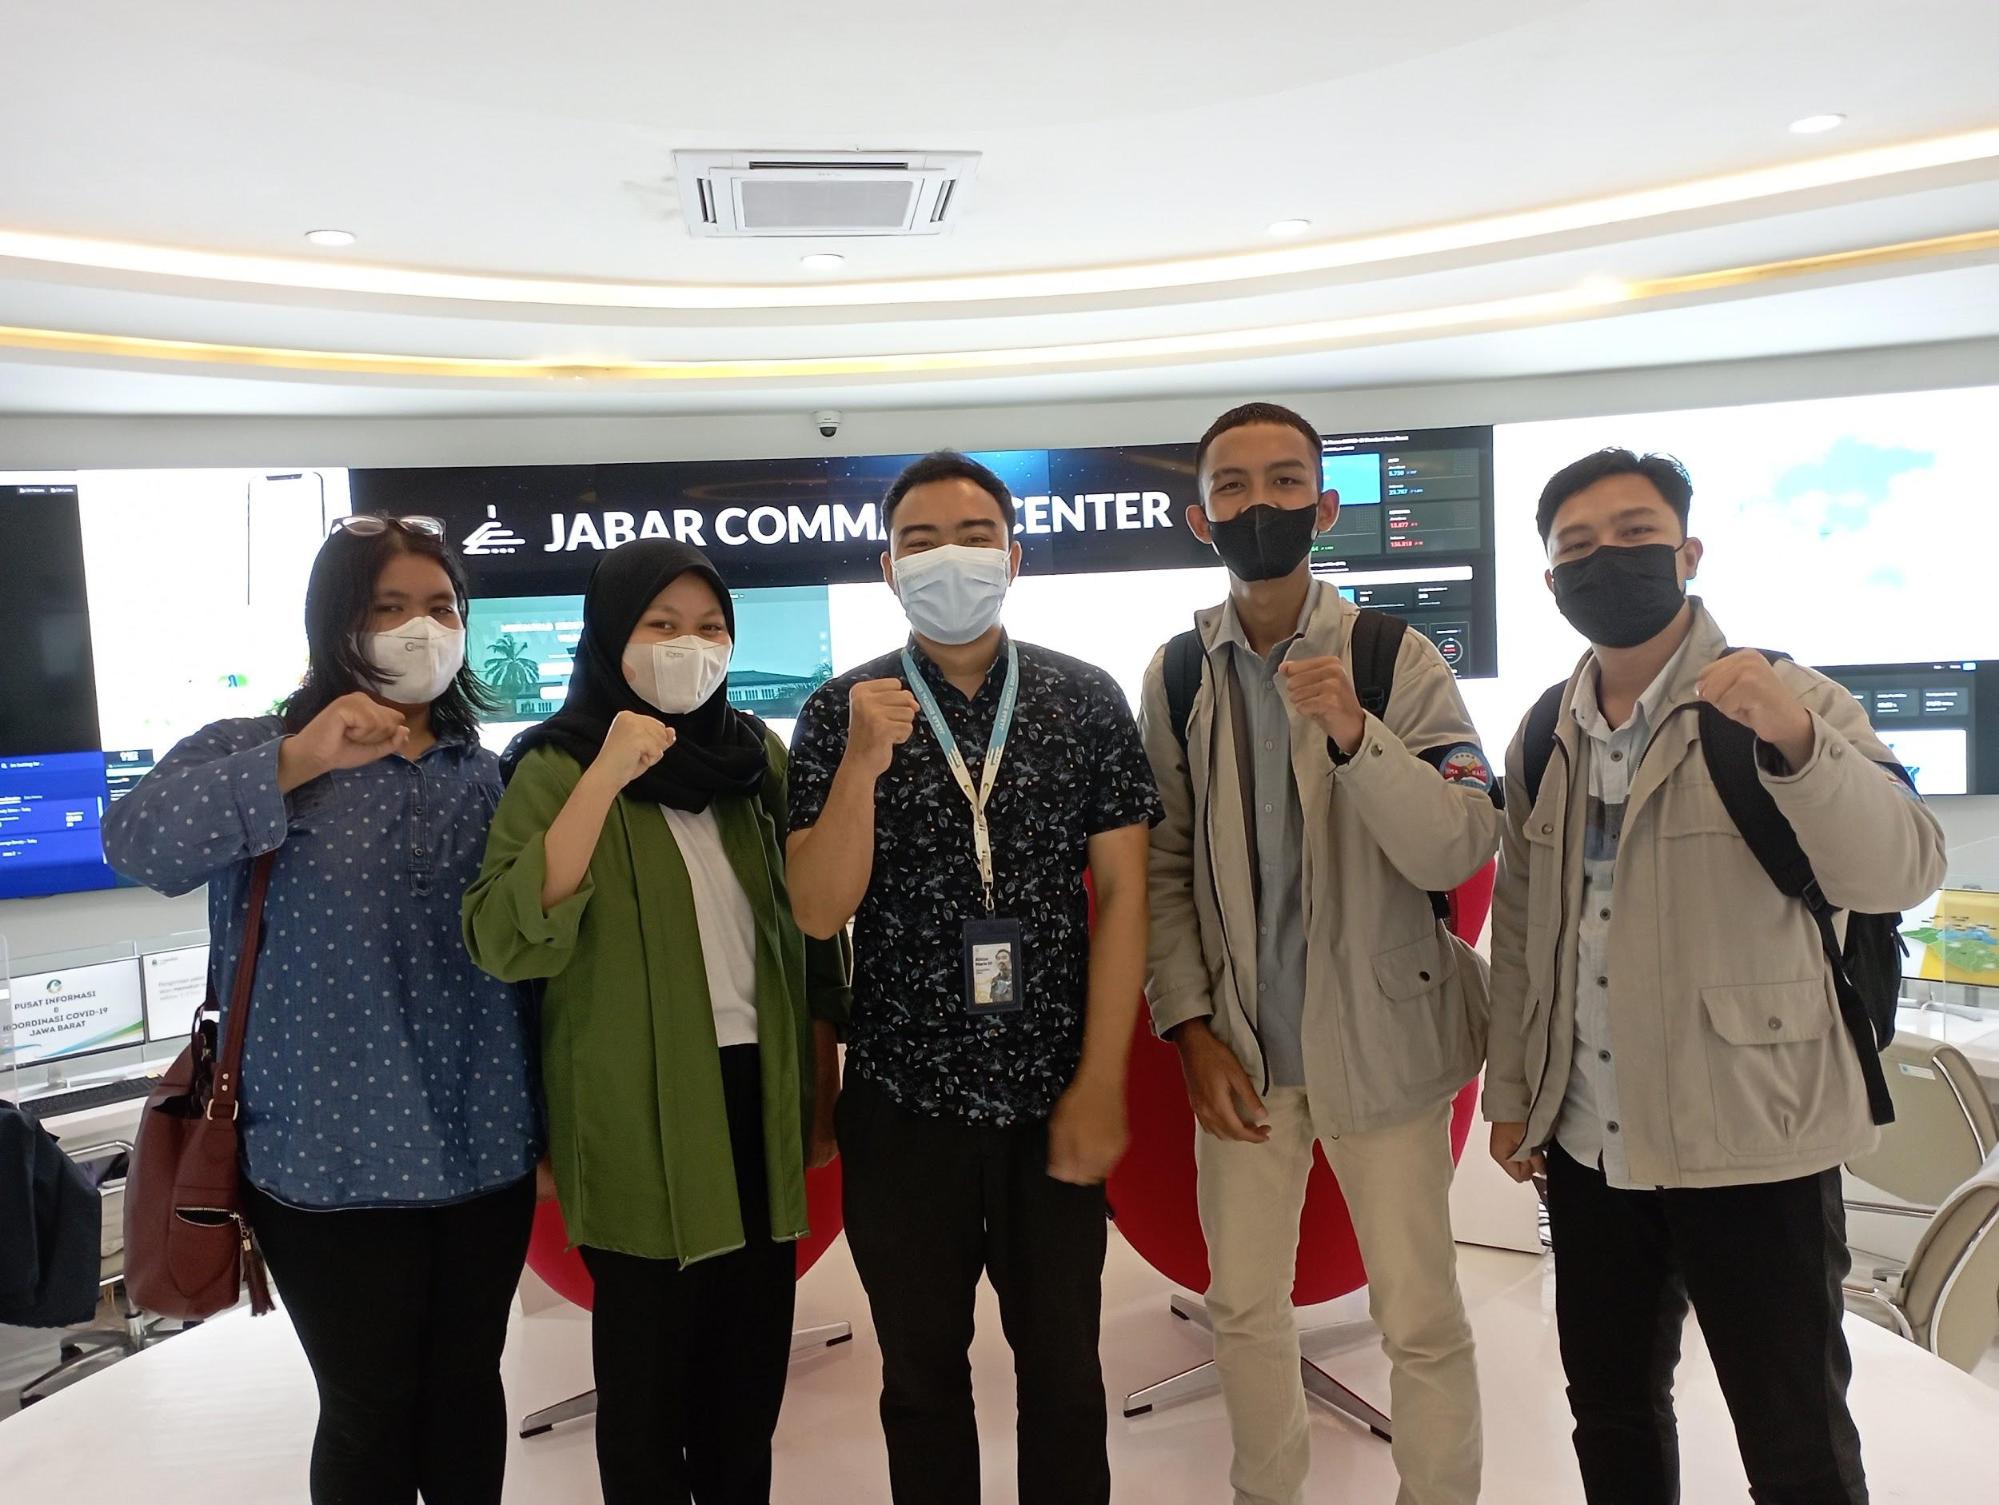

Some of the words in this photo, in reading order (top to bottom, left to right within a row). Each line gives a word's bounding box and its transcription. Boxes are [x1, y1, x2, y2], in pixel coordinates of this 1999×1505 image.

[544, 509, 708, 552] JABAR
[715, 502, 888, 546] COMM
[14, 999, 43, 1010] PUSAT
[45, 990, 96, 1005] INFORMASI
[65, 1007, 108, 1020] COVID-19
[29, 1026, 55, 1036] JAWA
[57, 1020, 86, 1032] BARAT
